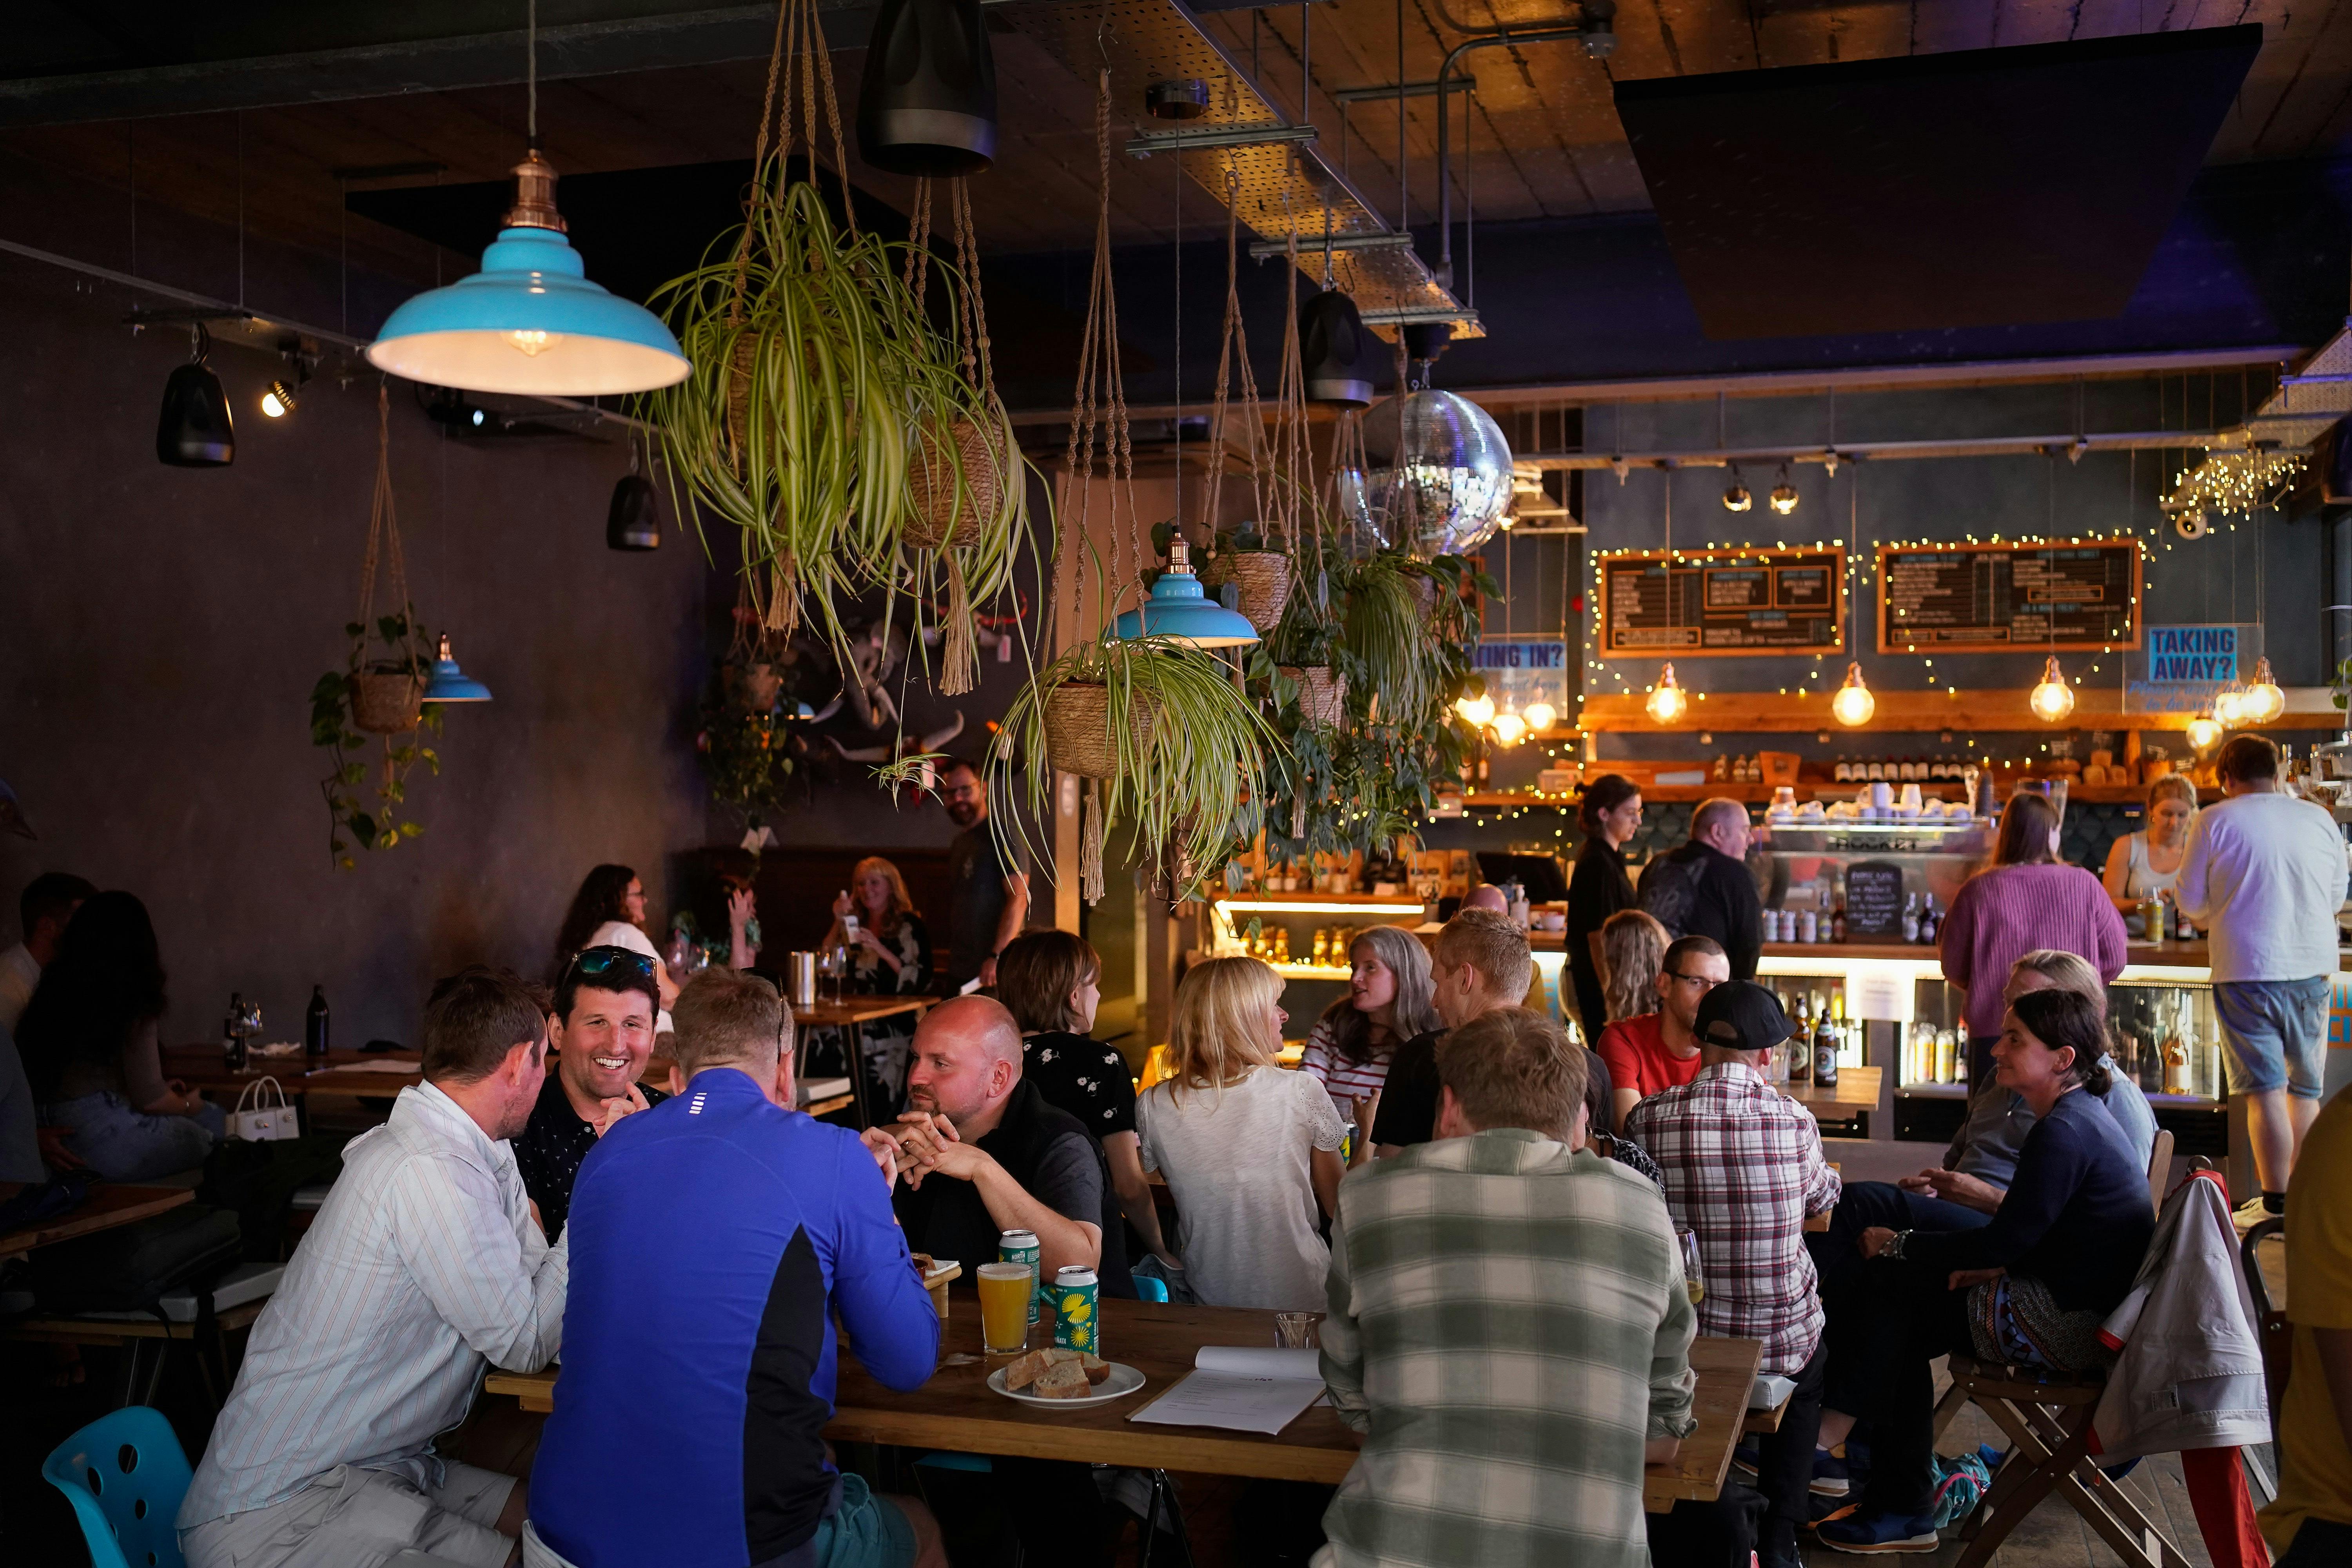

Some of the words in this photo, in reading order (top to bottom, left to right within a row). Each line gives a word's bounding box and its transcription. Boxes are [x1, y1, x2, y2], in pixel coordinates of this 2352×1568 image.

[2153, 628, 2234, 655] TAKING
[1530, 644, 1563, 667] IN?
[2154, 656, 2232, 680] AWAY?
